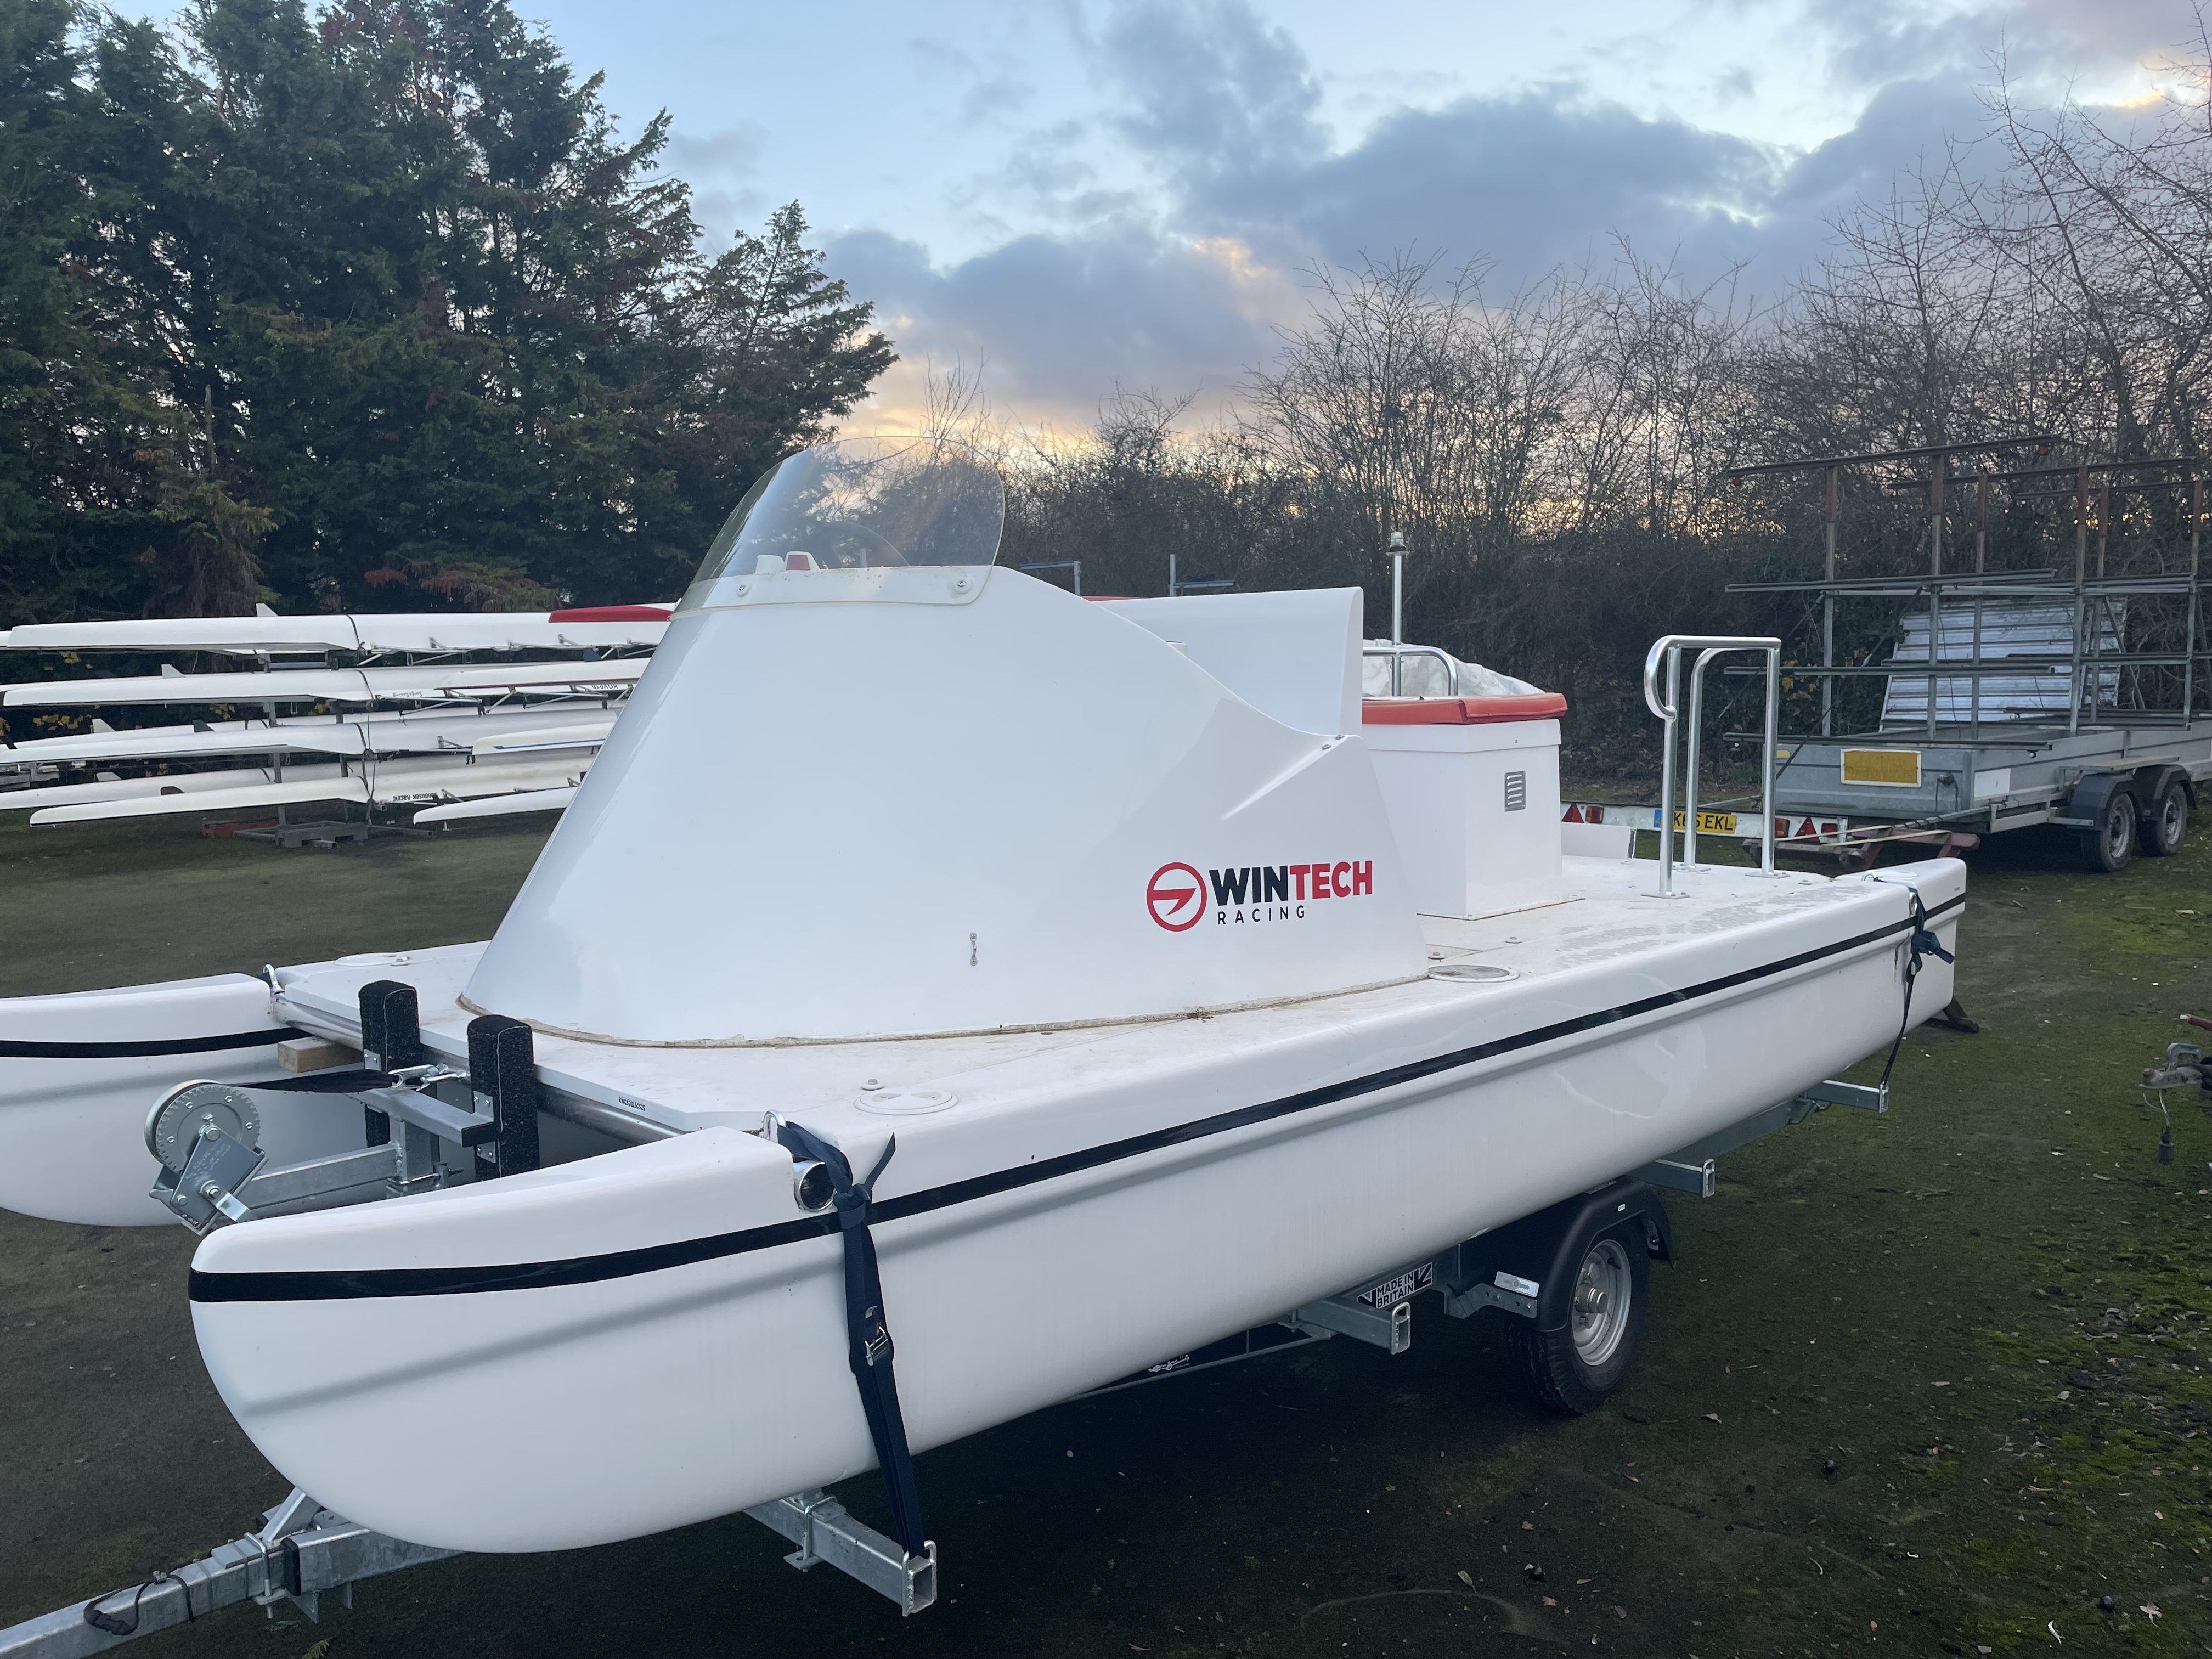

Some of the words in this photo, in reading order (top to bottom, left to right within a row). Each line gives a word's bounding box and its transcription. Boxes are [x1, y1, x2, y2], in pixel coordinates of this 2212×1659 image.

[1705, 815, 1733, 831] EKL
[1209, 860, 1372, 906] WINTECH
[1217, 905, 1305, 925] RACING
[1378, 1277, 1402, 1297] MADE
[1404, 1272, 1413, 1284] IN
[1378, 1283, 1413, 1308] BRITAIN
